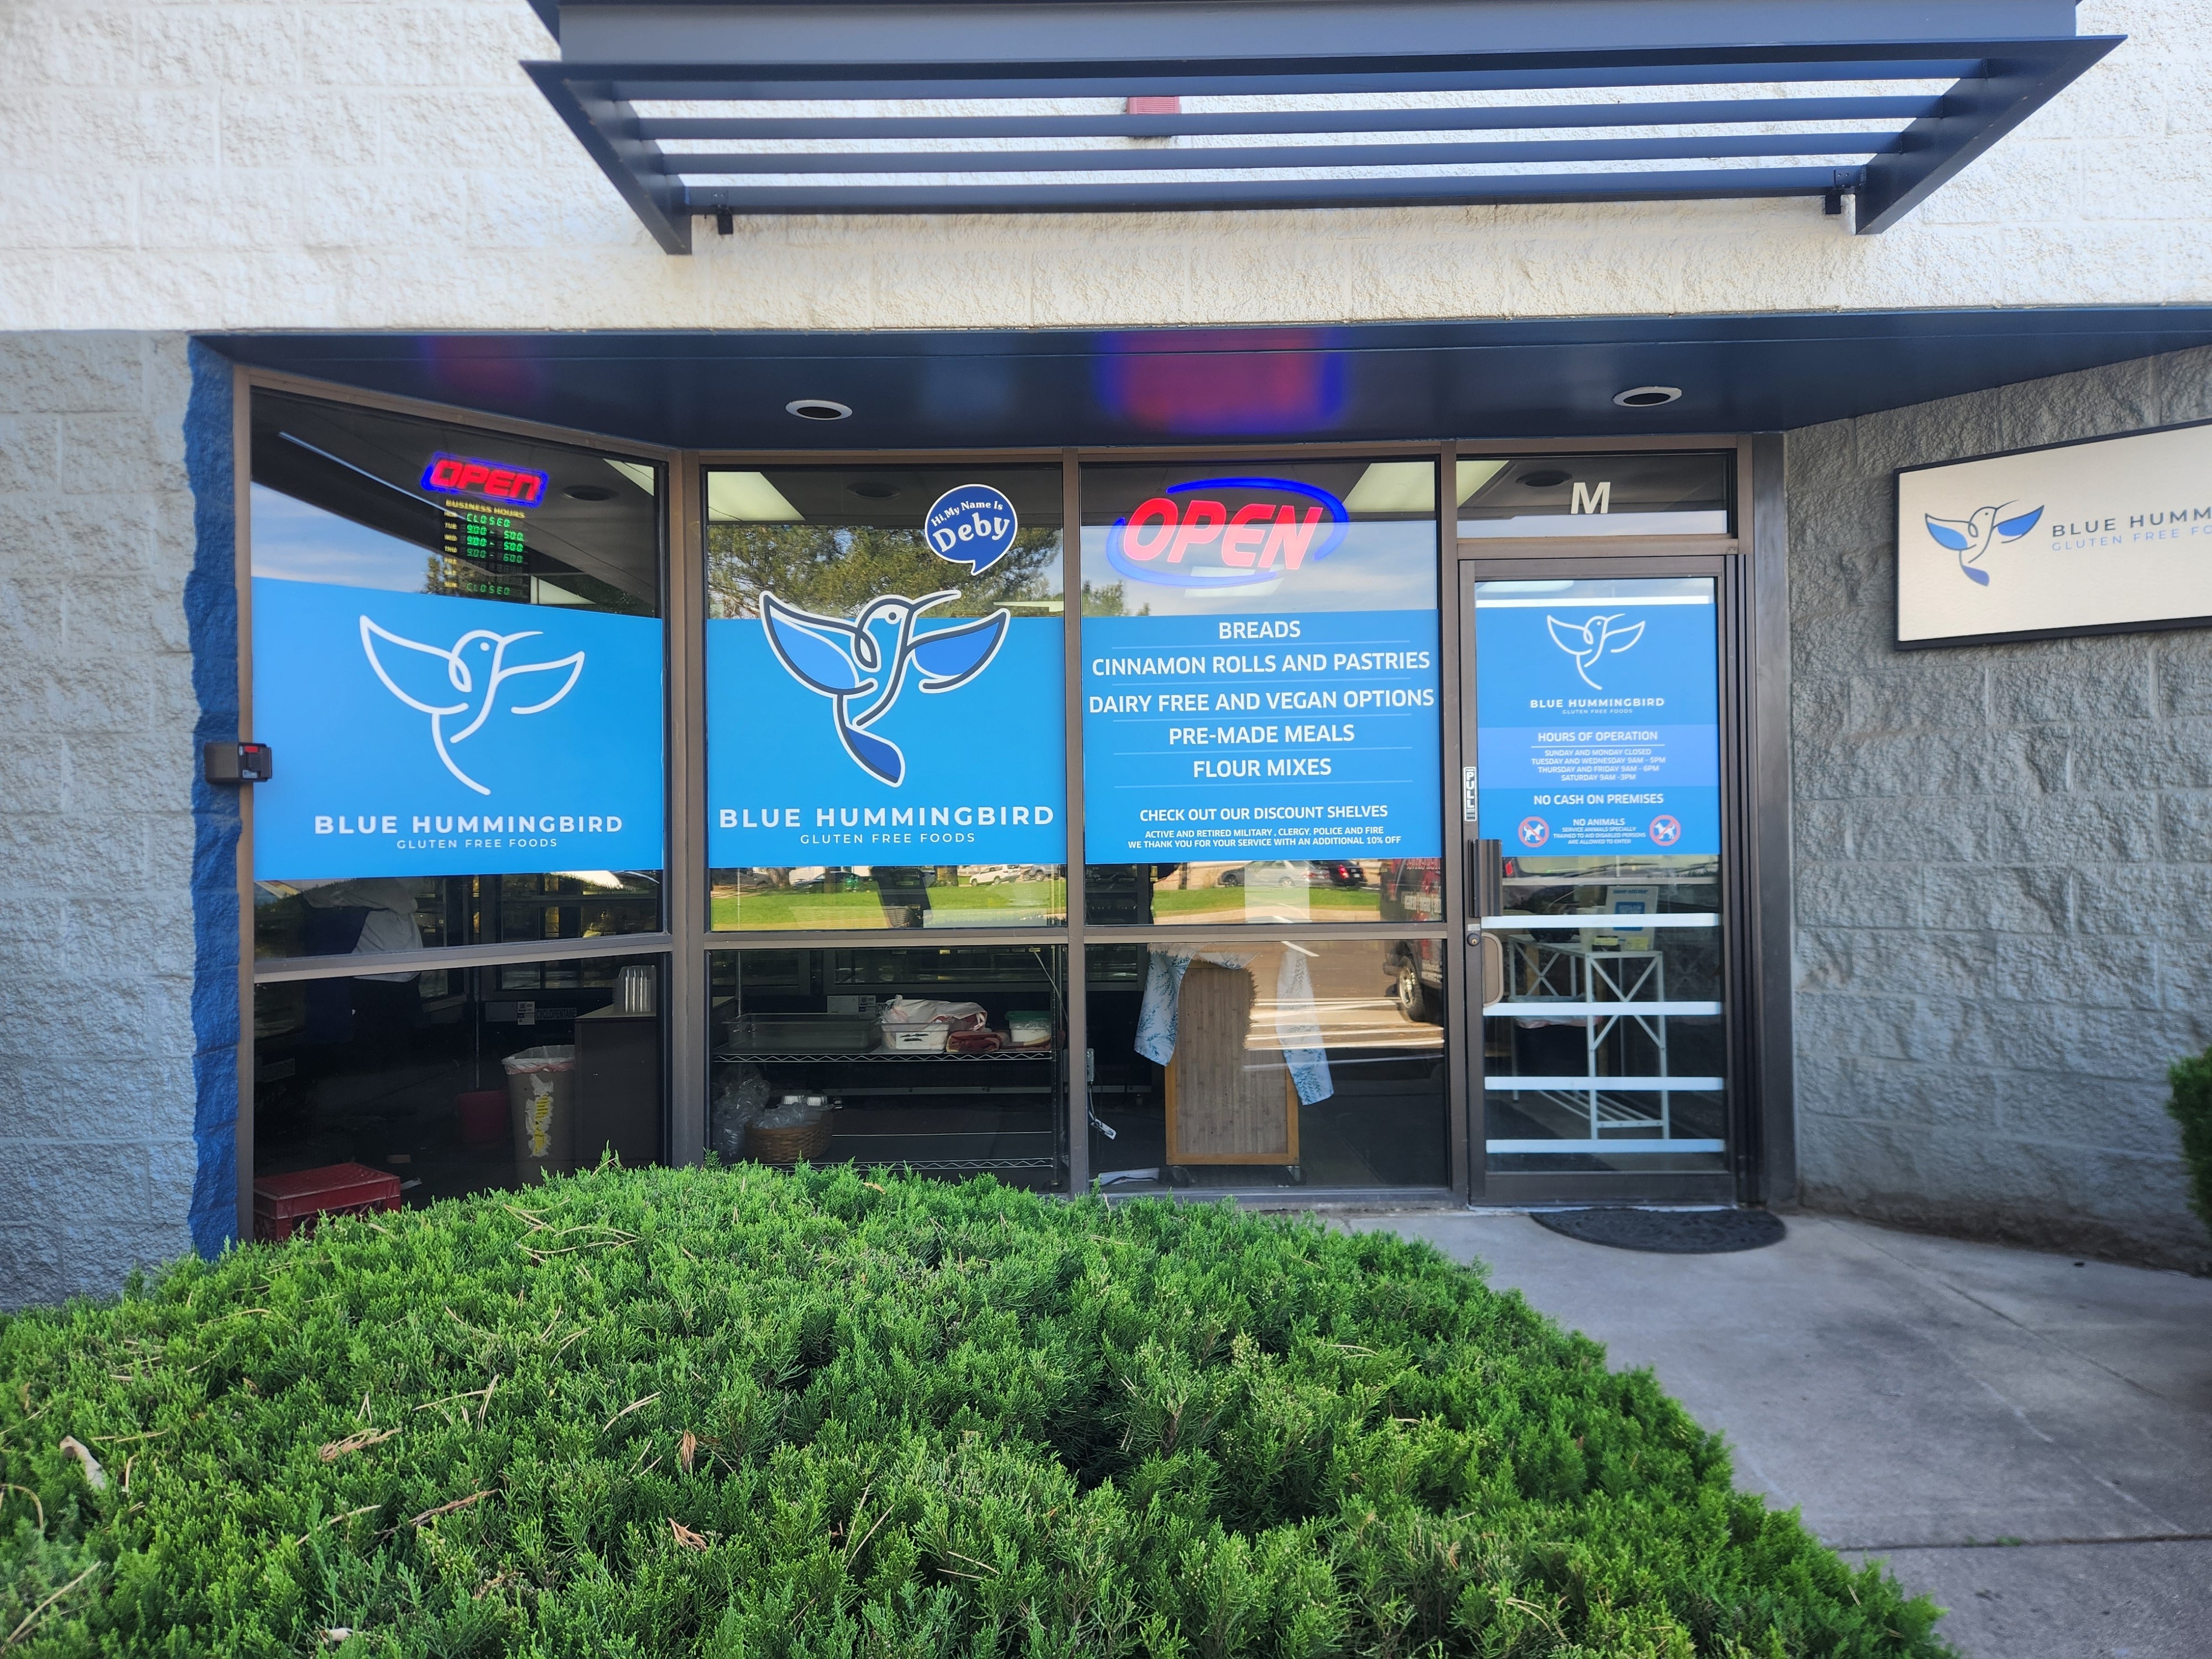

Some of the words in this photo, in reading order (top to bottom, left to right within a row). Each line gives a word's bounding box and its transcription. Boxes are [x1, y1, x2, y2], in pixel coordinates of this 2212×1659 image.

[431, 460, 542, 501] OPEN
[1571, 482, 1610, 514] M
[445, 499, 493, 513] BUSINESS
[494, 507, 526, 519] HOURS
[943, 507, 960, 519] My
[961, 500, 992, 511] Name
[994, 500, 1003, 510] Is
[466, 512, 511, 528] CLOSED
[2052, 518, 2116, 538] BLUE
[932, 512, 1010, 552] Deby
[1123, 497, 1324, 570] OPEN
[2052, 535, 2122, 552] GLUTEN
[2133, 528, 2180, 542] FREE
[466, 582, 511, 596] CLOSED
[1219, 620, 1301, 639] BREADS
[1092, 656, 1206, 676] CINNAMON
[1213, 655, 1276, 674] ROLLS
[1281, 654, 1327, 672] AND
[1334, 651, 1431, 671] PASTRIES
[1089, 695, 1152, 713] DAIRY
[1159, 693, 1209, 711] FREE
[1215, 692, 1260, 711] AND
[1265, 691, 1337, 709] VEGAN
[1343, 689, 1434, 708] OPTIONS
[1530, 700, 1563, 708] BLUE
[1568, 698, 1665, 707] HUMMINGBIRD
[1169, 726, 1279, 745] PRE-MADE
[1285, 724, 1355, 743] MEALS
[1538, 732, 1575, 742] HOURS
[1578, 732, 1593, 741] OF
[1595, 731, 1658, 741] OPERATION
[1194, 760, 1261, 778] FLOUR
[1267, 758, 1332, 776] MIXES
[1465, 771, 1475, 808] PULL
[1533, 795, 1551, 805] NO
[1554, 795, 1584, 805] CASH
[1587, 794, 1604, 804] ON
[1607, 794, 1663, 804] PREMISES
[719, 808, 801, 828] BLUE
[816, 806, 1054, 827] HUMMINGBIRD
[1140, 809, 1185, 822] CHECK
[1188, 808, 1217, 821] OUT
[1220, 808, 1250, 820] OUR
[1254, 806, 1324, 820] DISCOUNT
[1327, 805, 1389, 818] SHELVES
[315, 816, 398, 834] BLUE
[413, 816, 623, 833] HUMMINGBIRD
[1233, 828, 1272, 837] MILITARY
[397, 839, 458, 849] GLUTEN
[465, 839, 502, 848] FREE
[509, 838, 557, 848] FOODS
[800, 834, 864, 844] GLUTEN
[872, 833, 912, 843] FREE
[920, 832, 975, 843] FOODS
[1128, 841, 1141, 849] WE
[1144, 840, 1173, 848] THANK
[1175, 839, 1192, 848] YOU
[1238, 838, 1272, 847] SERVICE
[1312, 837, 1364, 845] ADDITIONAL
[1366, 836, 1383, 844] 10%
[1385, 836, 1402, 844] OFF
